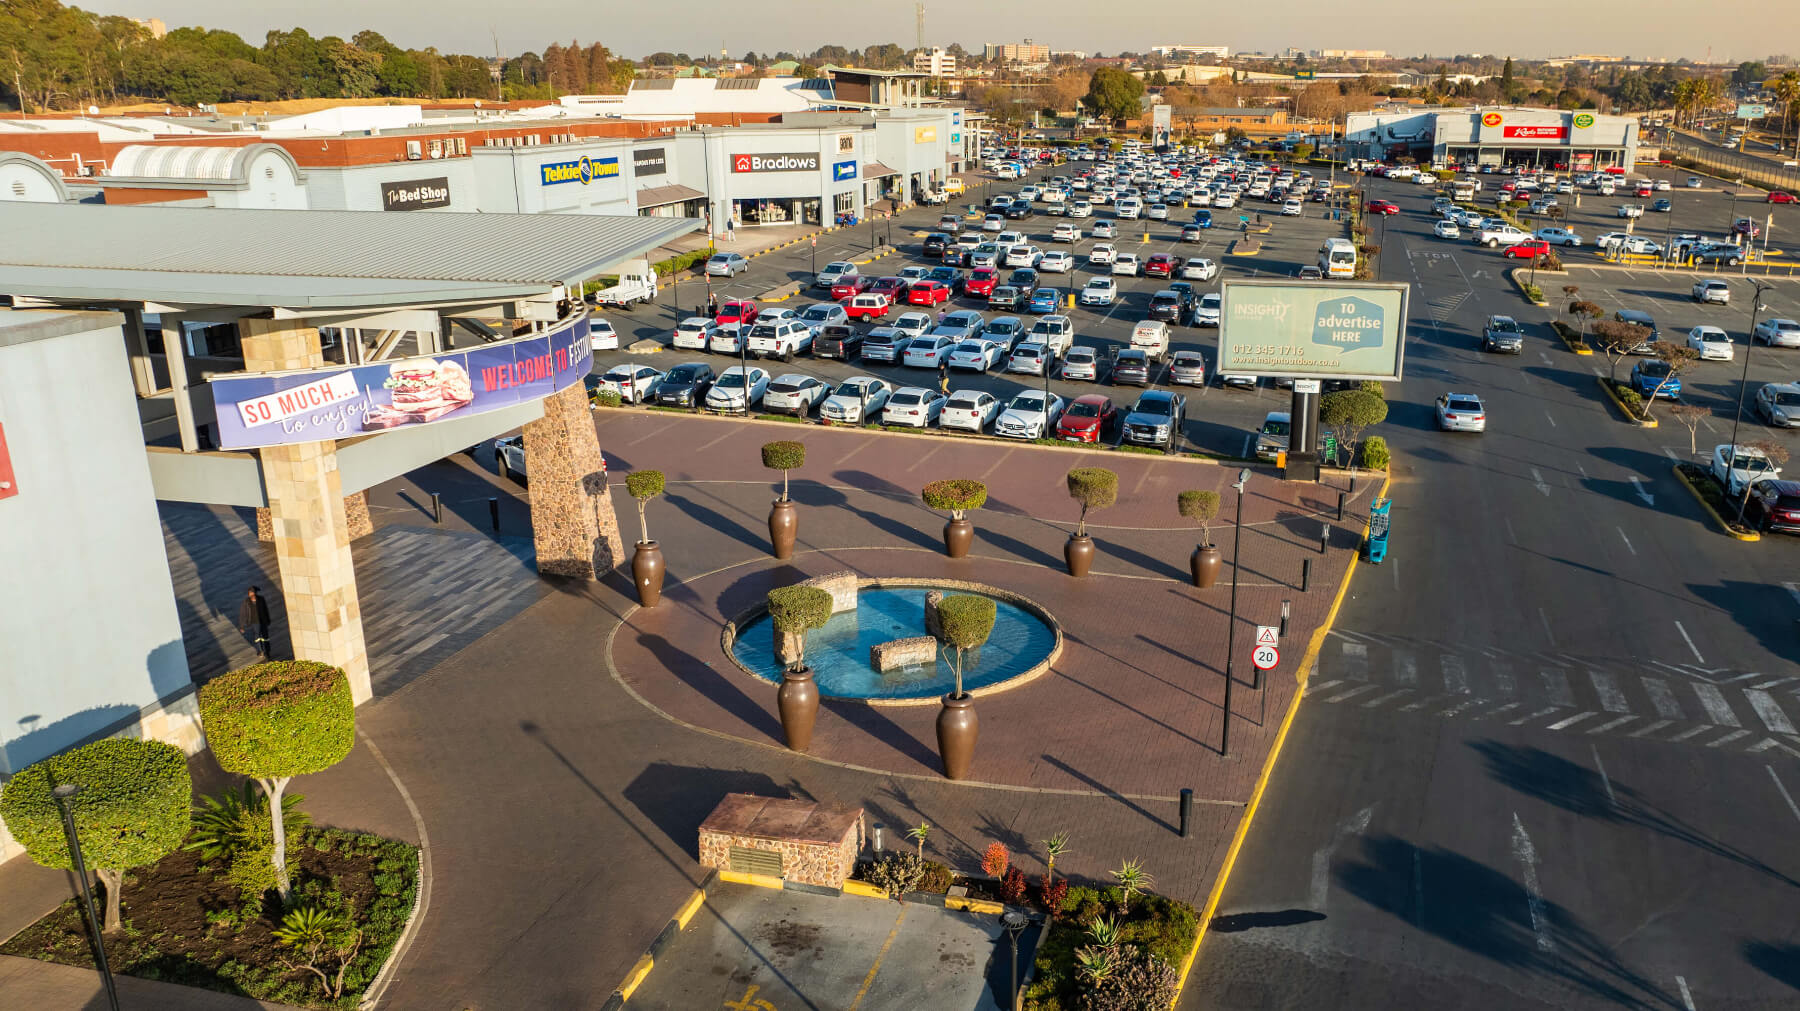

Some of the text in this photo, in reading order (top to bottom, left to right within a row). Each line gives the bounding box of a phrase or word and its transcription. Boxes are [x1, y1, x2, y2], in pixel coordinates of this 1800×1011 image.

[751, 156, 816, 170] Bradlows
[543, 162, 619, 183] Tekkie Town
[399, 188, 420, 202] Bed
[420, 187, 447, 201] Shop
[1234, 303, 1282, 316] INSIGHT
[1340, 303, 1356, 314] TO
[1318, 313, 1381, 328] advertise
[1332, 331, 1360, 342] HERE
[1232, 343, 1305, 356] 012 345 1716
[481, 354, 553, 392] WELCOME
[555, 347, 568, 373] TO
[244, 382, 355, 424] SO MUCH...
[274, 384, 375, 434] to enjoy!
[1258, 651, 1273, 662] 20
